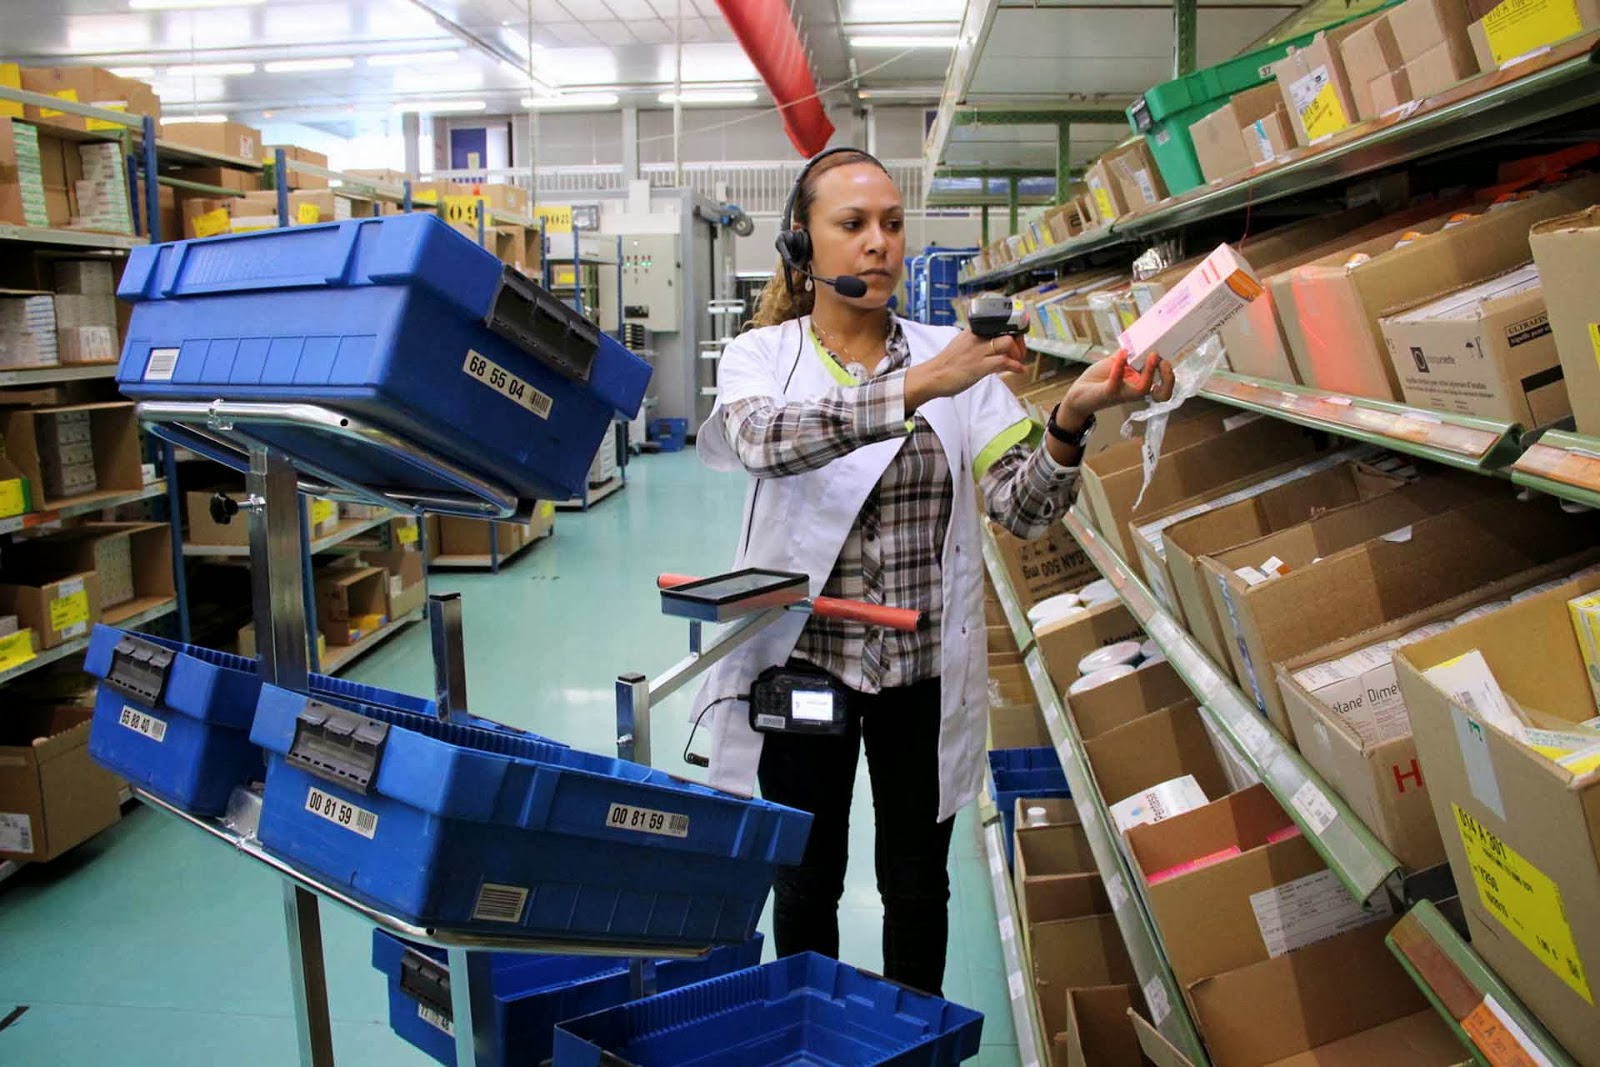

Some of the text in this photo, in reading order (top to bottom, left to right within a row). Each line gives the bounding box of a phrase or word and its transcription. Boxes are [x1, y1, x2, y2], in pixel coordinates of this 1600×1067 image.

[1260, 66, 1271, 77] 37
[469, 355, 525, 399] 68 55 04
[1022, 564, 1040, 580] mg
[1041, 558, 1061, 578] 500
[309, 791, 352, 824] 00 81 59
[612, 807, 664, 830] 00 81 59
